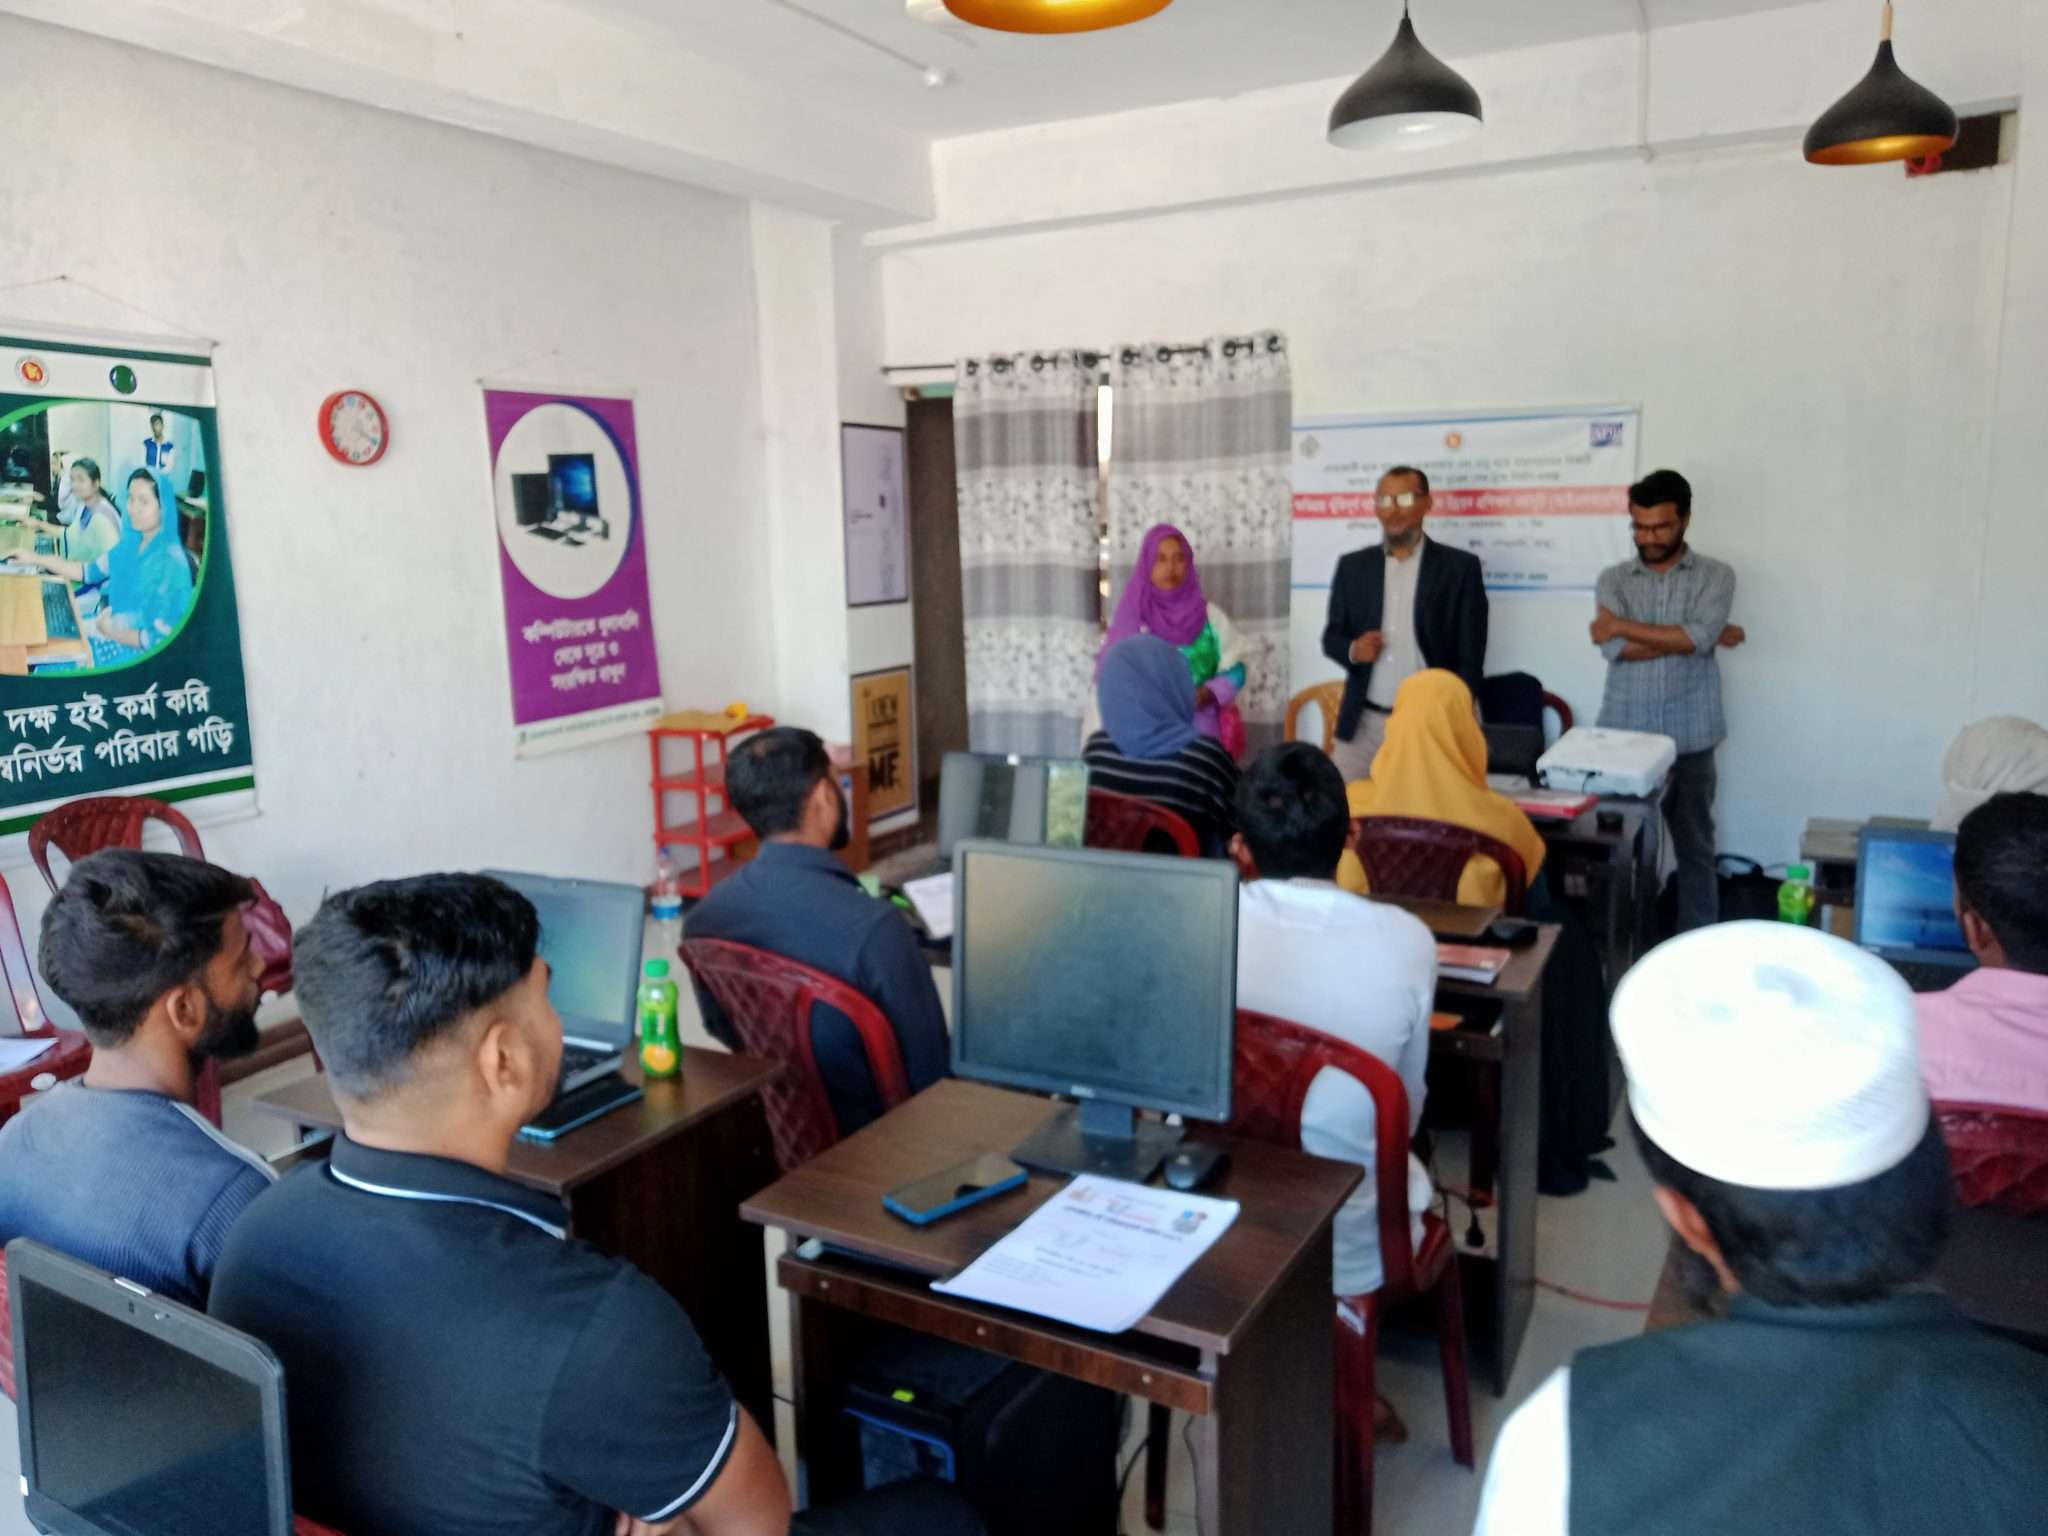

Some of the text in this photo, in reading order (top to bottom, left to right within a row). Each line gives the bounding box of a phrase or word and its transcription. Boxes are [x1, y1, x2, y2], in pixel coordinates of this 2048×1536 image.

[3, 678, 211, 738] দক্ষ হই কর্ম করি
[94, 728, 181, 768] পরিবার
[186, 715, 235, 755] গড়ি
